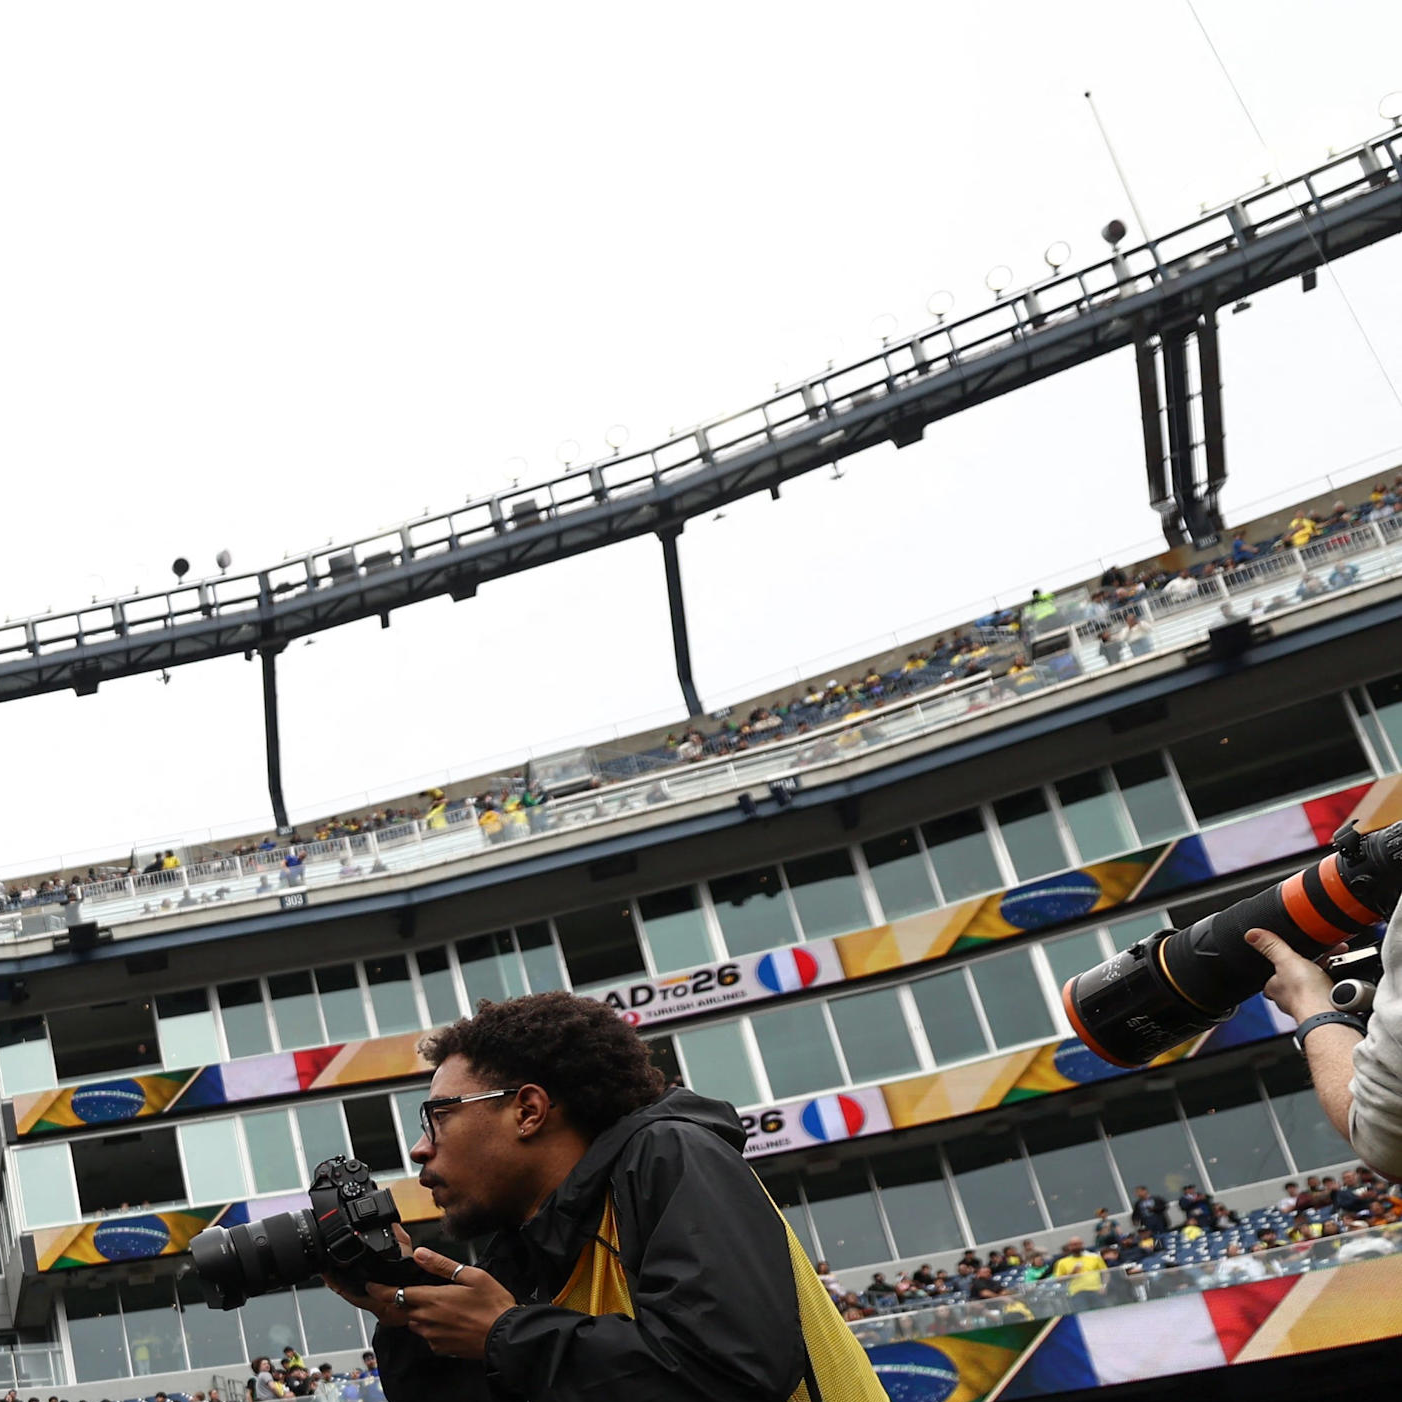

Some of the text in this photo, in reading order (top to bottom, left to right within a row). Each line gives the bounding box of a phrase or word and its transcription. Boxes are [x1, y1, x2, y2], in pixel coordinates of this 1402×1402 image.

[285, 894, 304, 906] 303
[647, 991, 747, 1018] TURKISH AIRLINES
